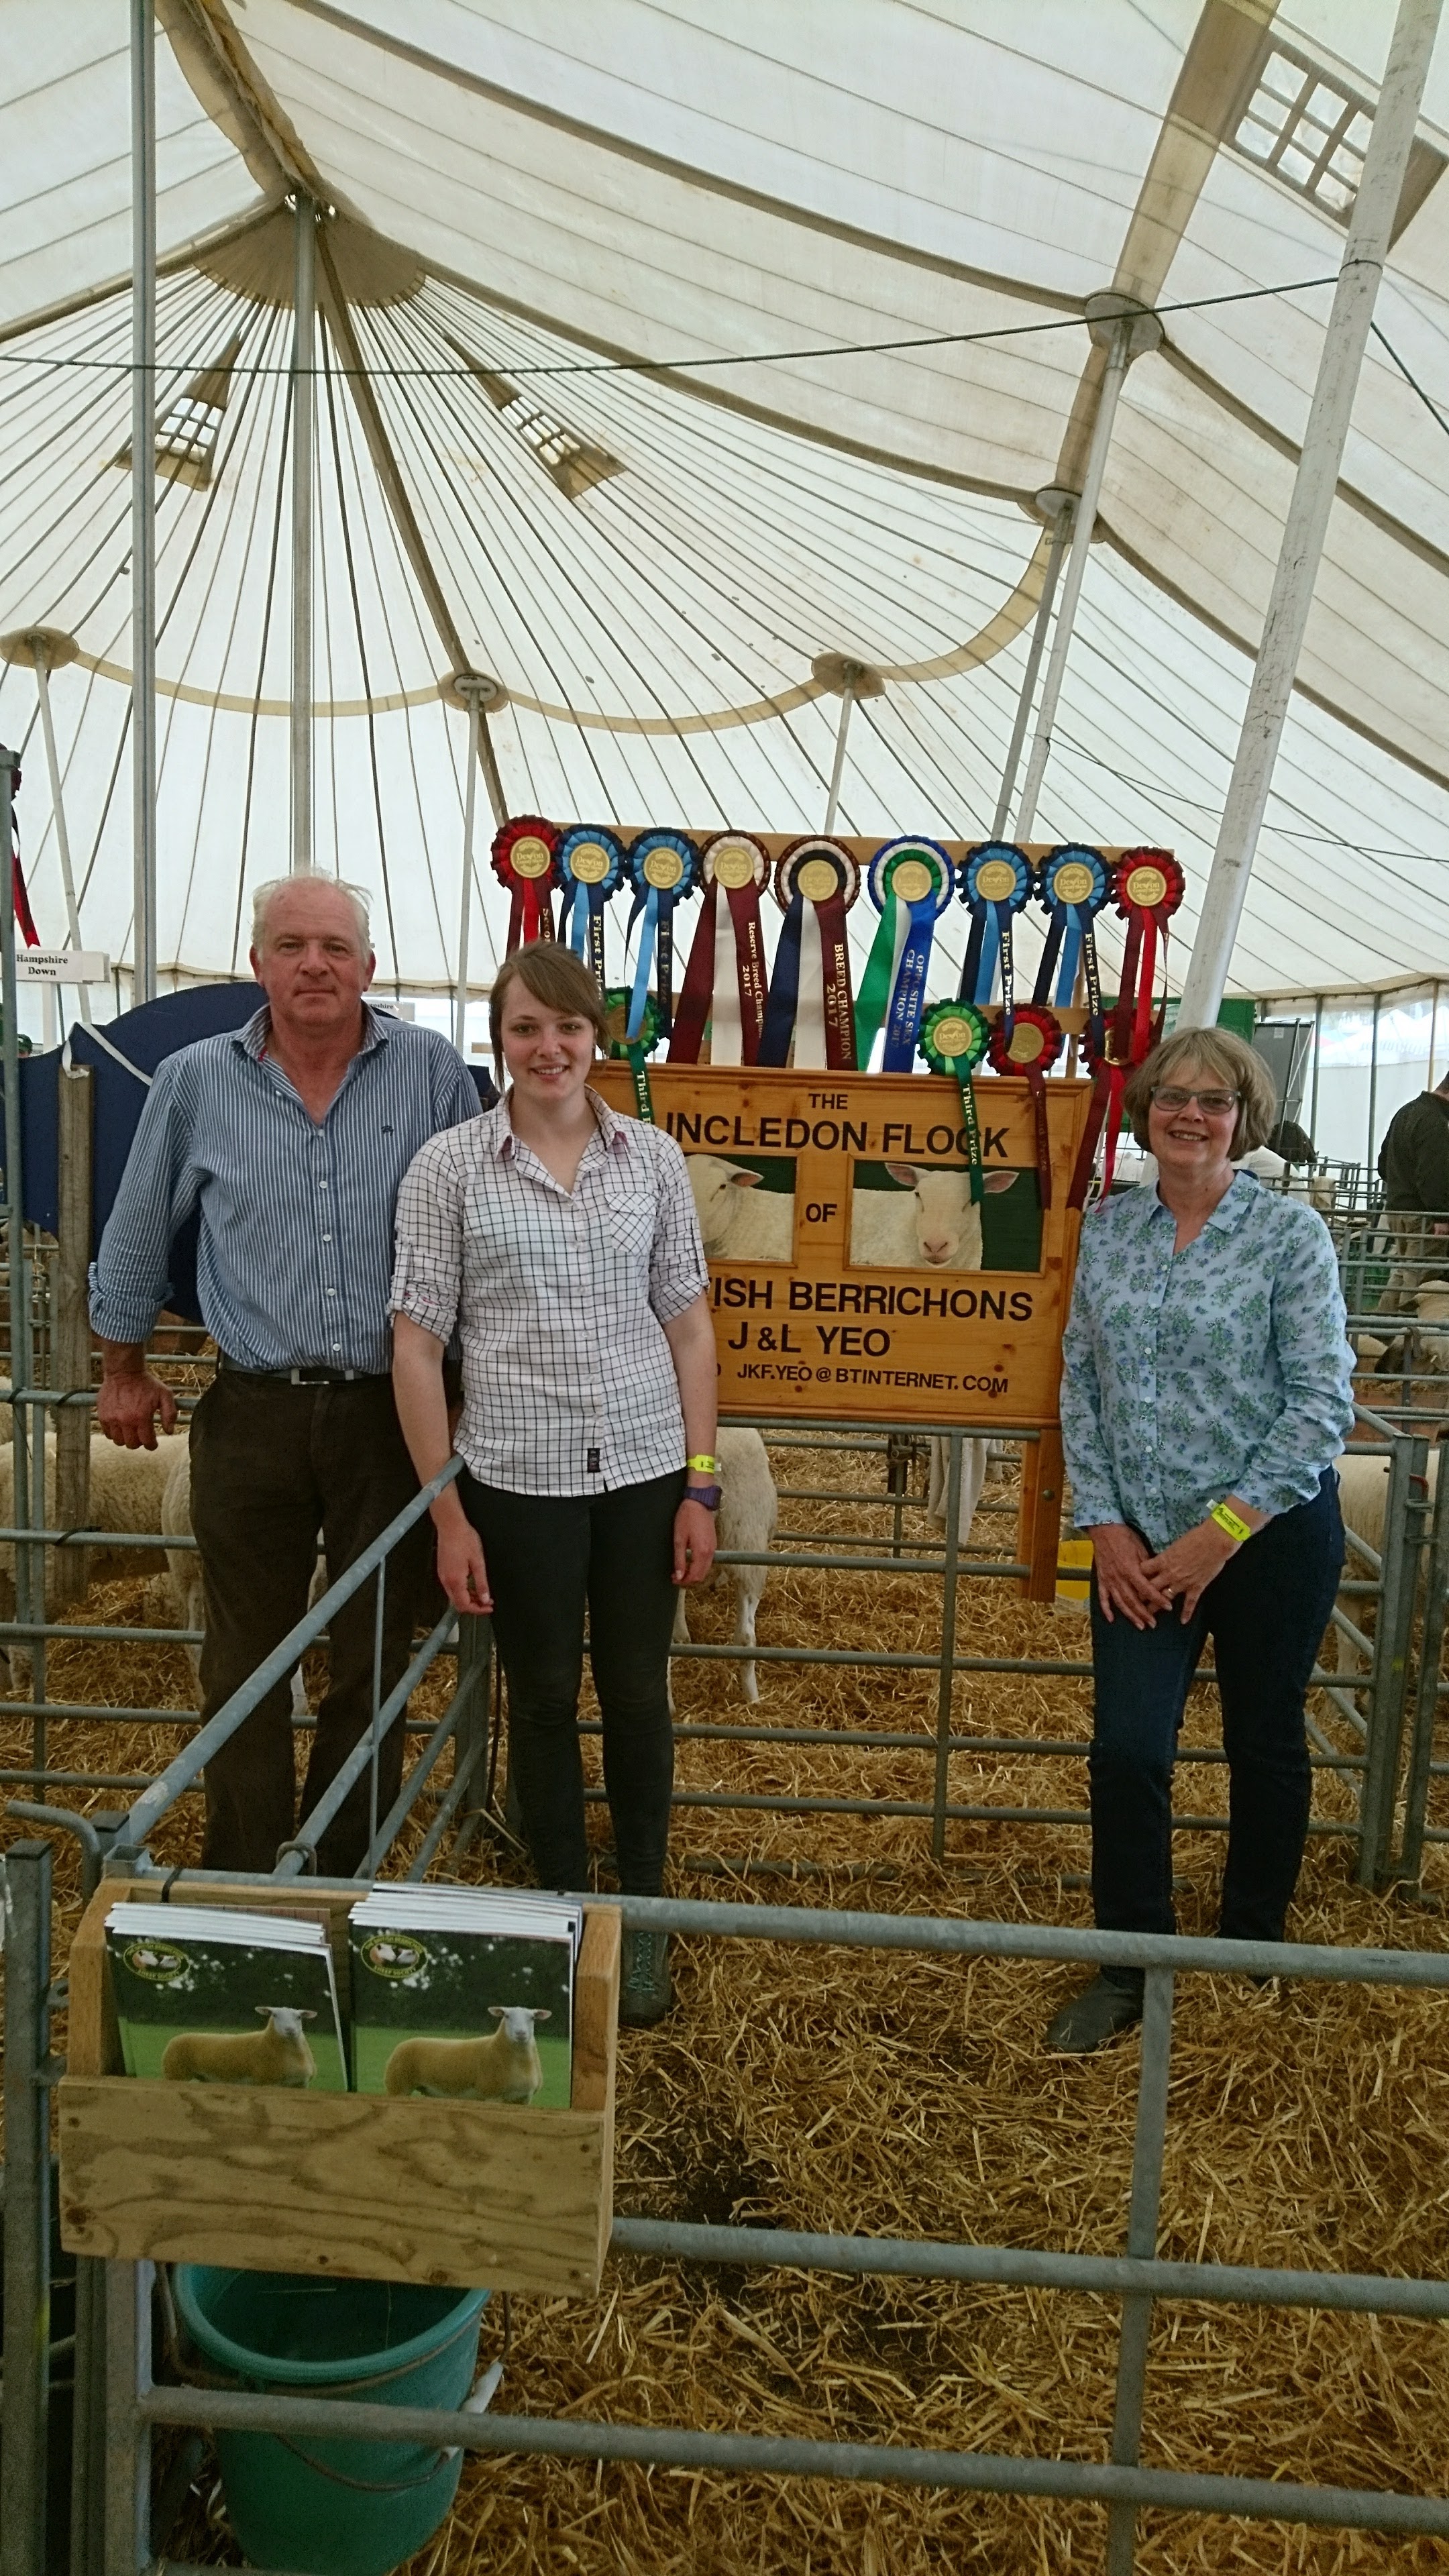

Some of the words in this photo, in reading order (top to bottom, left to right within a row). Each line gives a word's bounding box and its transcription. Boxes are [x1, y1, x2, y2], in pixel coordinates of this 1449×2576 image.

[516, 851, 544, 861] Devon
[1133, 880, 1160, 889] Devon
[542, 908, 551, 943] Seco
[593, 914, 602, 954] First
[748, 921, 757, 959] Reserve
[16, 954, 68, 965] Hampshire
[834, 943, 847, 987] BREED
[1002, 931, 1011, 969] First
[1085, 932, 1095, 971] First
[28, 966, 56, 975] Down
[594, 959, 603, 1000] Pri
[742, 965, 752, 997] 2017
[751, 961, 762, 989] Breed
[895, 949, 916, 1020] CHAMPION
[906, 954, 925, 1018] OPPOSITE
[826, 983, 838, 1028] 2017
[1004, 975, 1013, 1015] Prize
[1089, 976, 1099, 1016] Prize
[837, 990, 853, 1060] CHAMPION
[637, 1071, 649, 1112] Third
[808, 1093, 849, 1110] THE
[665, 1112, 868, 1152] INCLEDON
[882, 1123, 1010, 1158] FLOCK
[963, 1083, 975, 1125] Third
[970, 1129, 978, 1165] Prize
[805, 1202, 838, 1223] OF
[708, 1277, 773, 1309] ISH
[789, 1281, 1033, 1322] BERRICHONS
[816, 1325, 891, 1357] YEO
